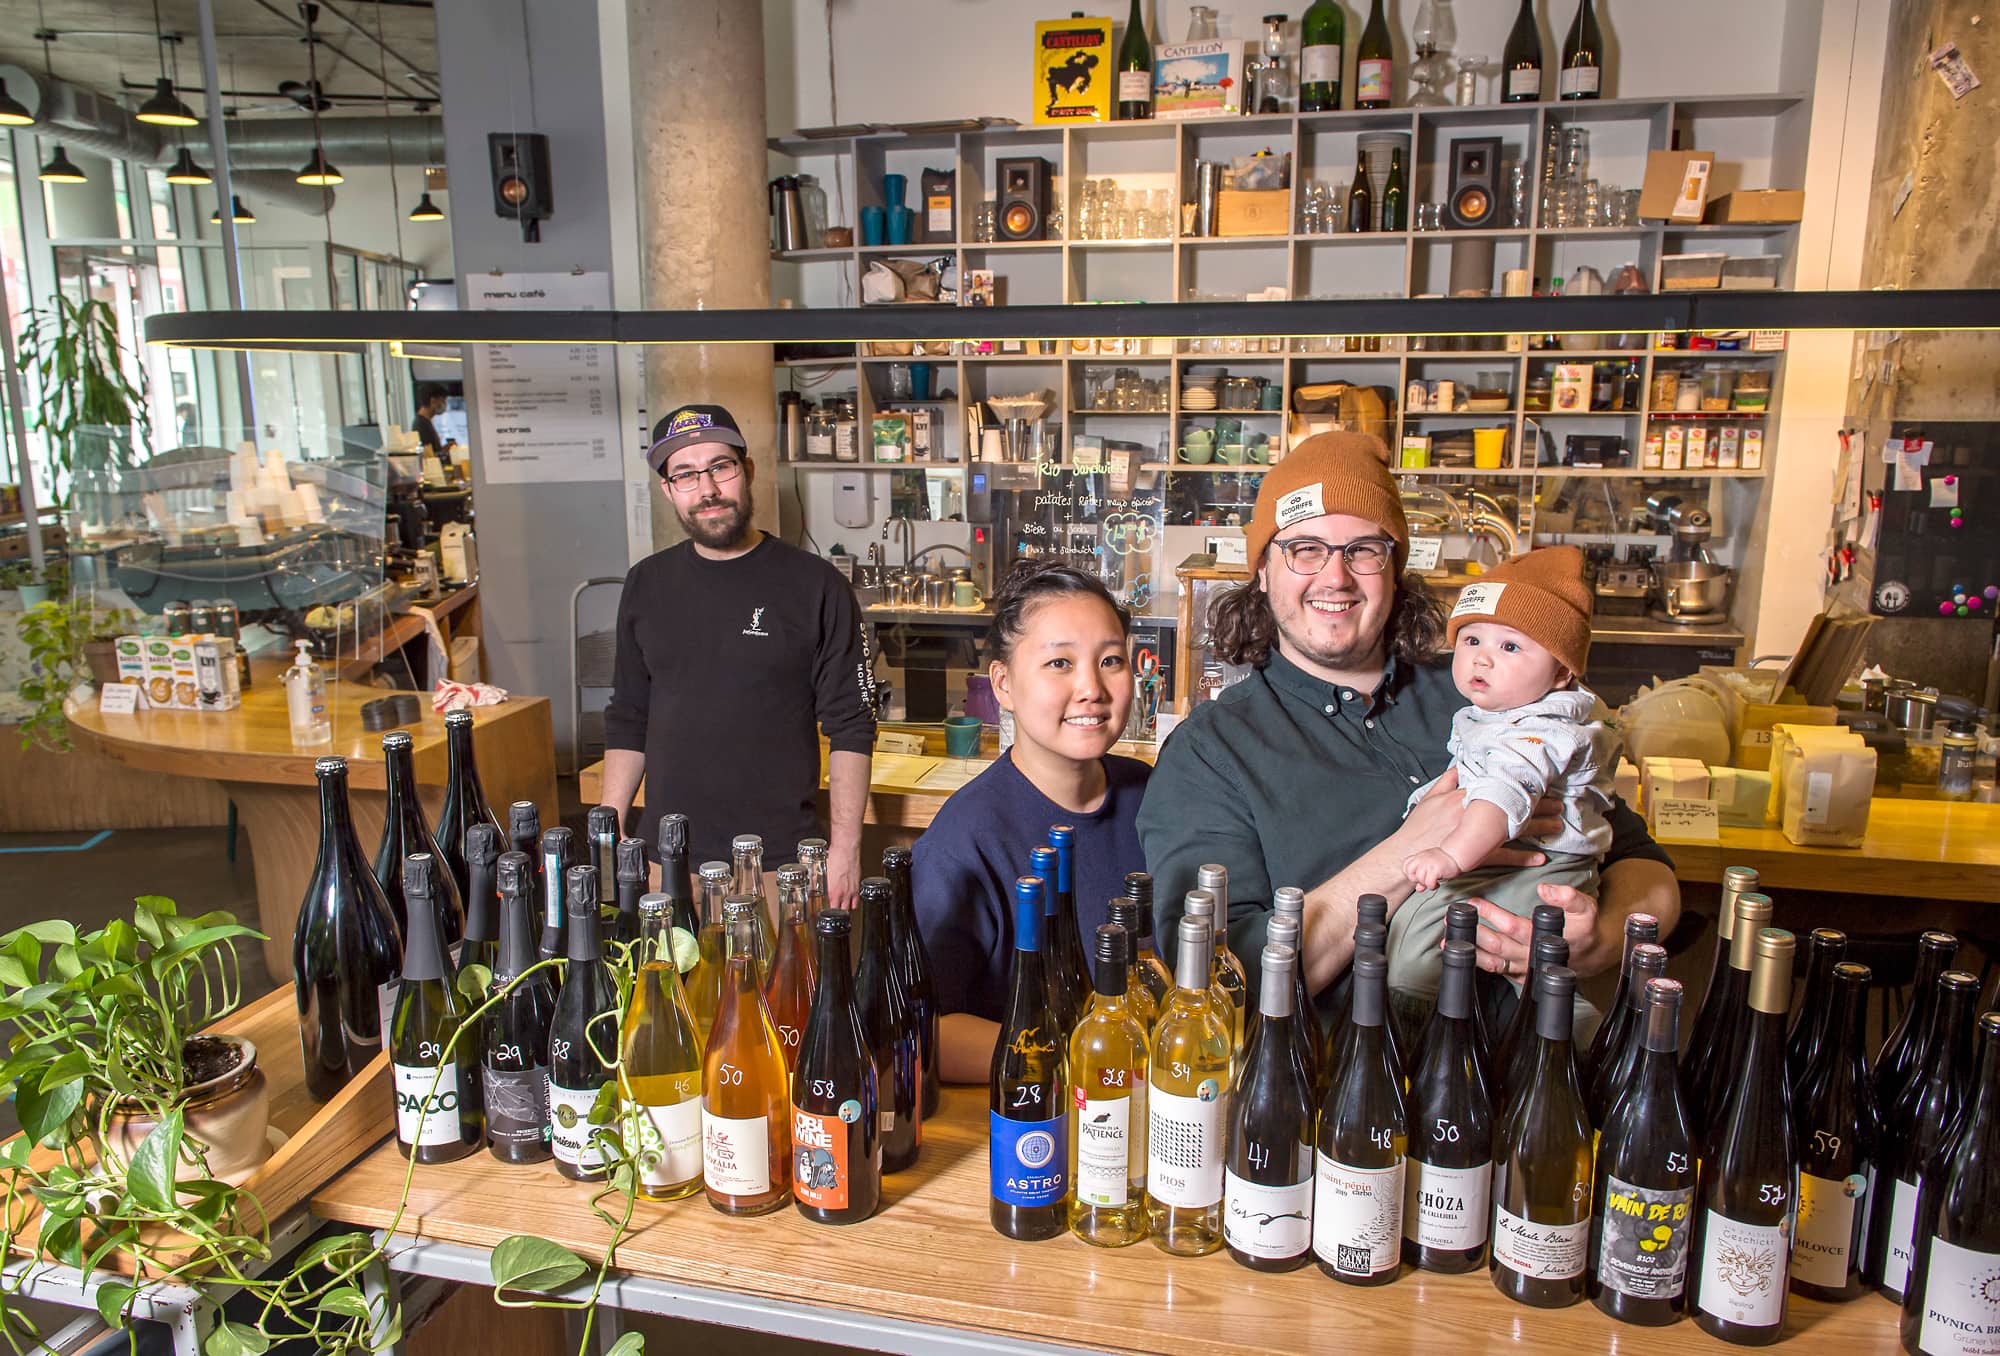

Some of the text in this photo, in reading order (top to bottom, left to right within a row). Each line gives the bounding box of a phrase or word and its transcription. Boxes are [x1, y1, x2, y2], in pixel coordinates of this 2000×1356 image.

[1046, 34, 1101, 48] CANTILLON
[1164, 41, 1224, 58] CANTILLON
[484, 288, 546, 299] menu café
[496, 426, 532, 434] extras
[1034, 490, 1072, 511] patates
[778, 1025, 800, 1047] 50
[419, 1040, 441, 1061] 29
[496, 1043, 523, 1066] 29
[552, 1038, 571, 1060] 38
[719, 1063, 744, 1086] 50
[1171, 1061, 1192, 1083] 34
[812, 1079, 836, 1099] 58
[1012, 1084, 1041, 1108] 28
[396, 1090, 459, 1114] PACO
[1082, 1122, 1124, 1141] PATIENCE
[1370, 1126, 1392, 1150] 48
[1432, 1118, 1460, 1143] 50
[1248, 1141, 1269, 1170] 41
[1810, 1129, 1842, 1160] 59
[1006, 1173, 1062, 1190] ASTRO
[1159, 1172, 1186, 1188] PIOS
[1416, 1189, 1465, 1211] CHOZA
[1647, 1203, 1673, 1222] DE
[1499, 1217, 1510, 1229] Le
[1510, 1224, 1540, 1241] Merle
[1722, 1229, 1776, 1247] Geschickt
[1339, 1251, 1370, 1265] SAINT
[1929, 1309, 1983, 1334] PIVNICA
